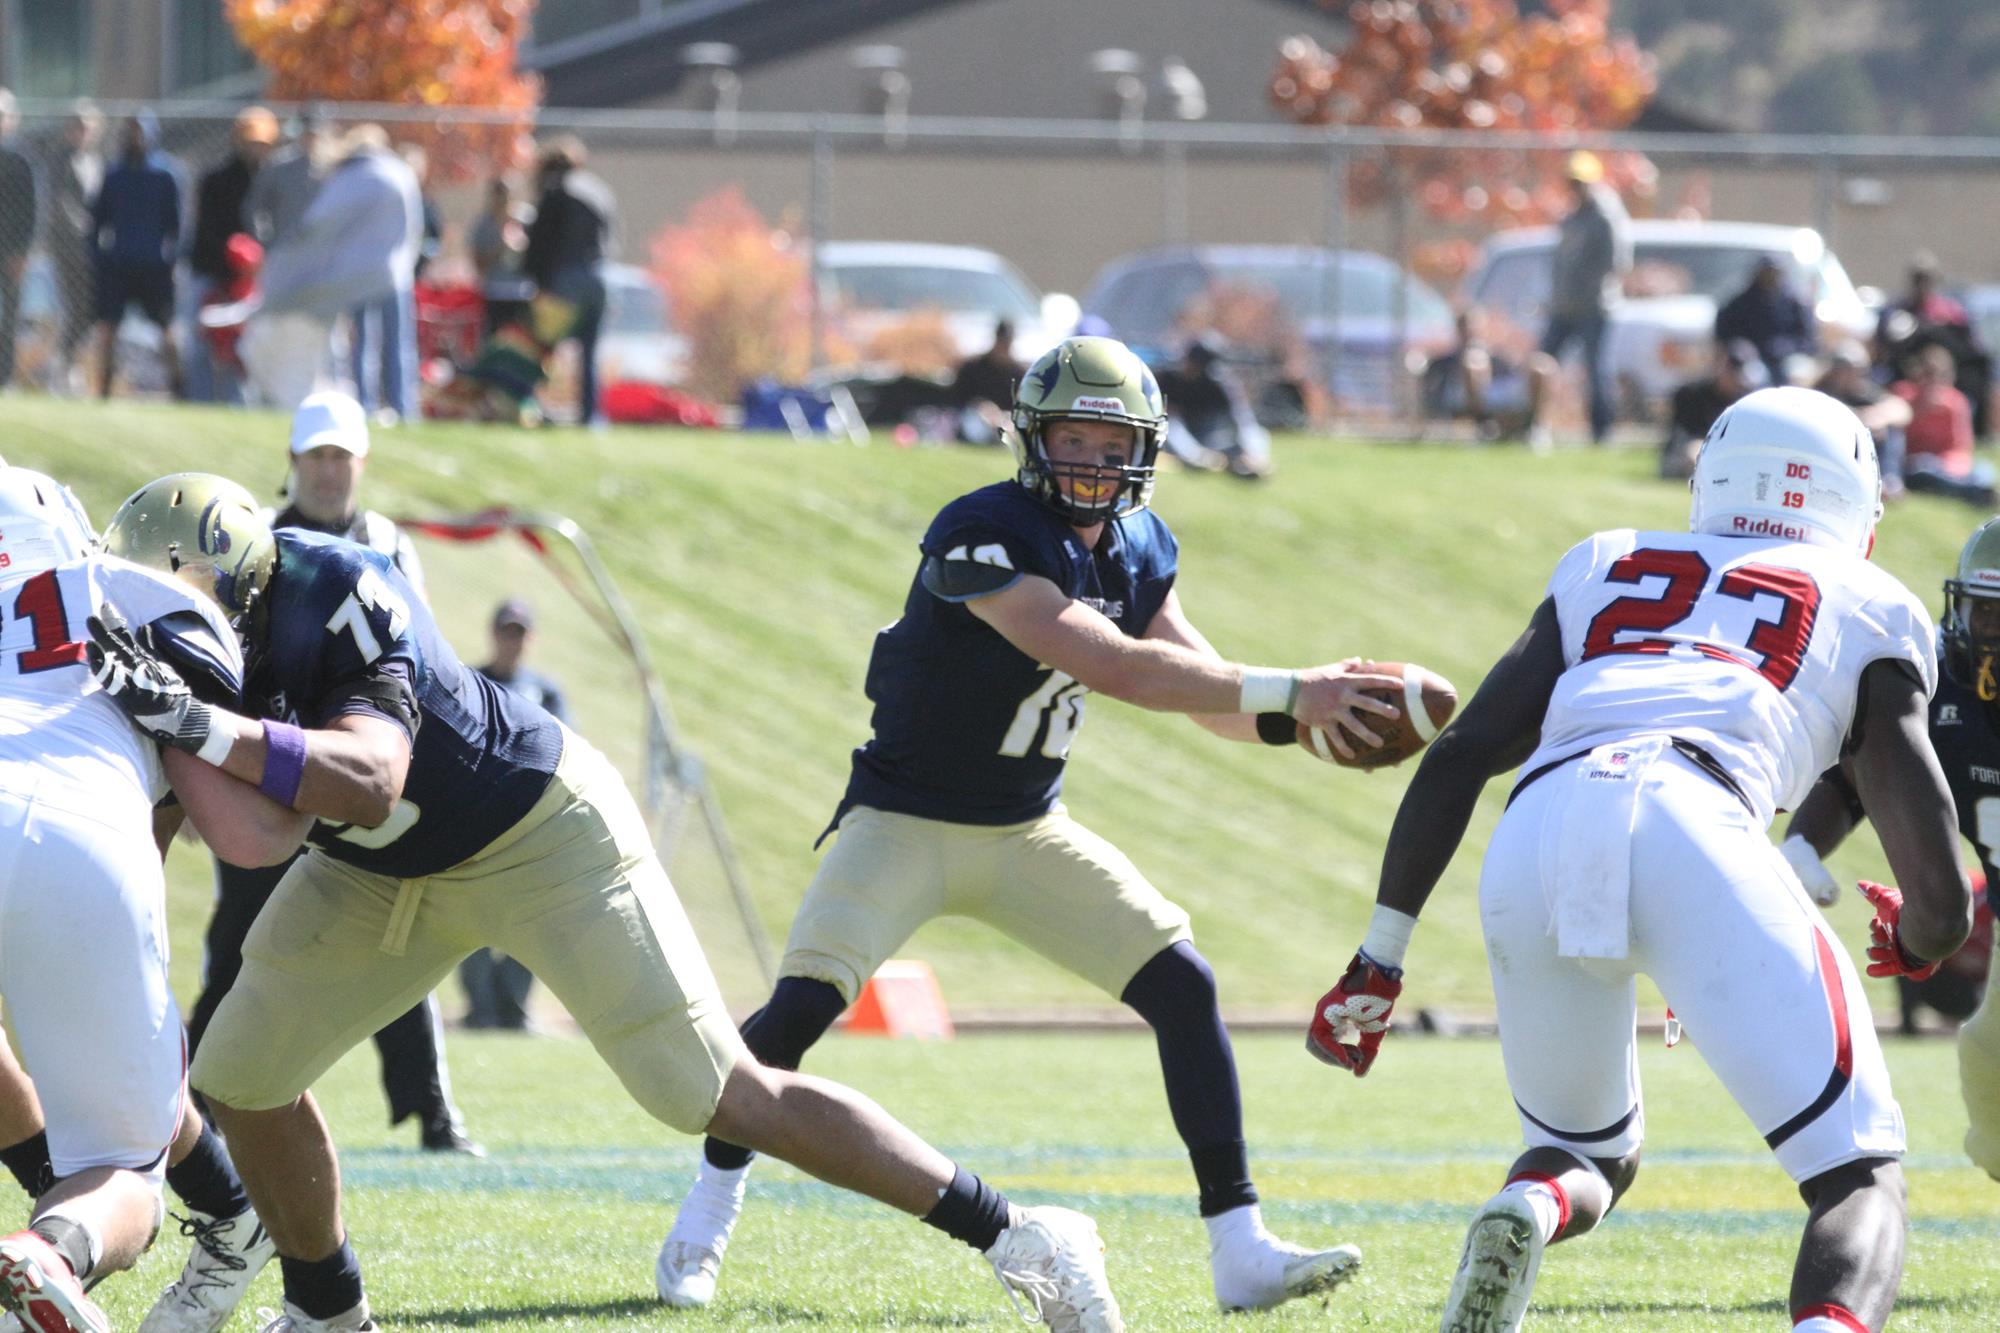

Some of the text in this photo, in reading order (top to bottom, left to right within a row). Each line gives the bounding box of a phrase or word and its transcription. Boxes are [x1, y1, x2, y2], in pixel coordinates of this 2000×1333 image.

[1079, 400, 1120, 410] Riddell
[1786, 462, 1810, 479] DC
[1782, 491, 1804, 508] 19
[1733, 516, 1804, 540] Riddel
[0, 568, 87, 674] 1
[1580, 547, 1822, 693] 23
